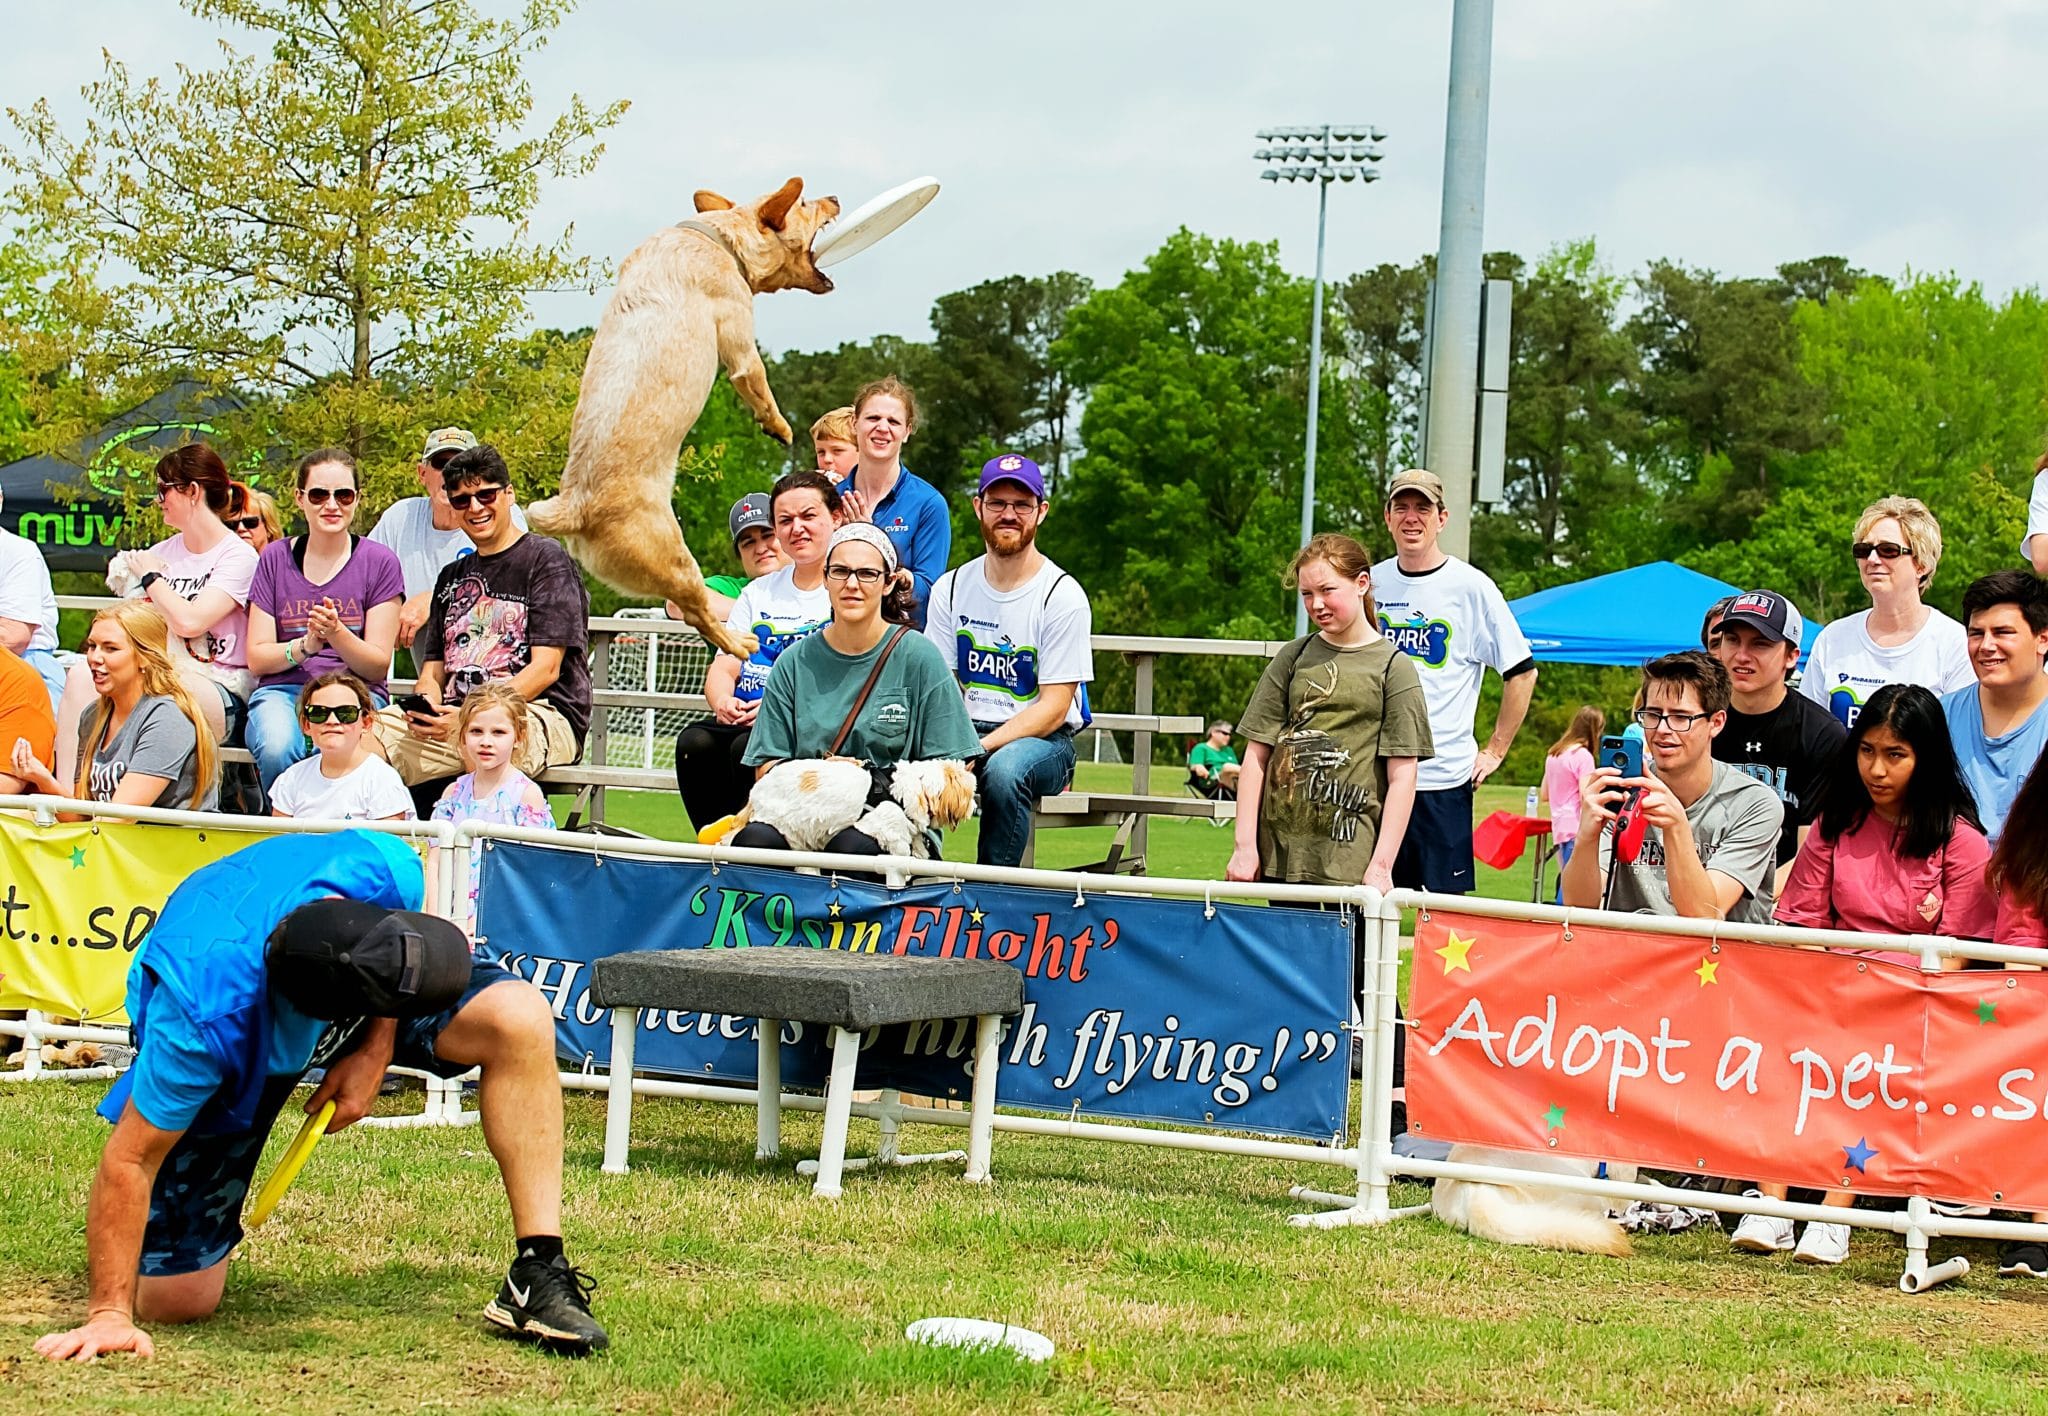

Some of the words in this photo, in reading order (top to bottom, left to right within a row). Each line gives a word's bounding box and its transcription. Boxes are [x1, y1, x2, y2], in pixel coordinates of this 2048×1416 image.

[281, 597, 359, 617] ARBA
[1384, 628, 1431, 649] BARK
[968, 649, 1018, 679] BARK
[903, 1002, 1048, 1078] hih
[1428, 994, 1690, 1113] Adopt
[1714, 1035, 1764, 1096] a
